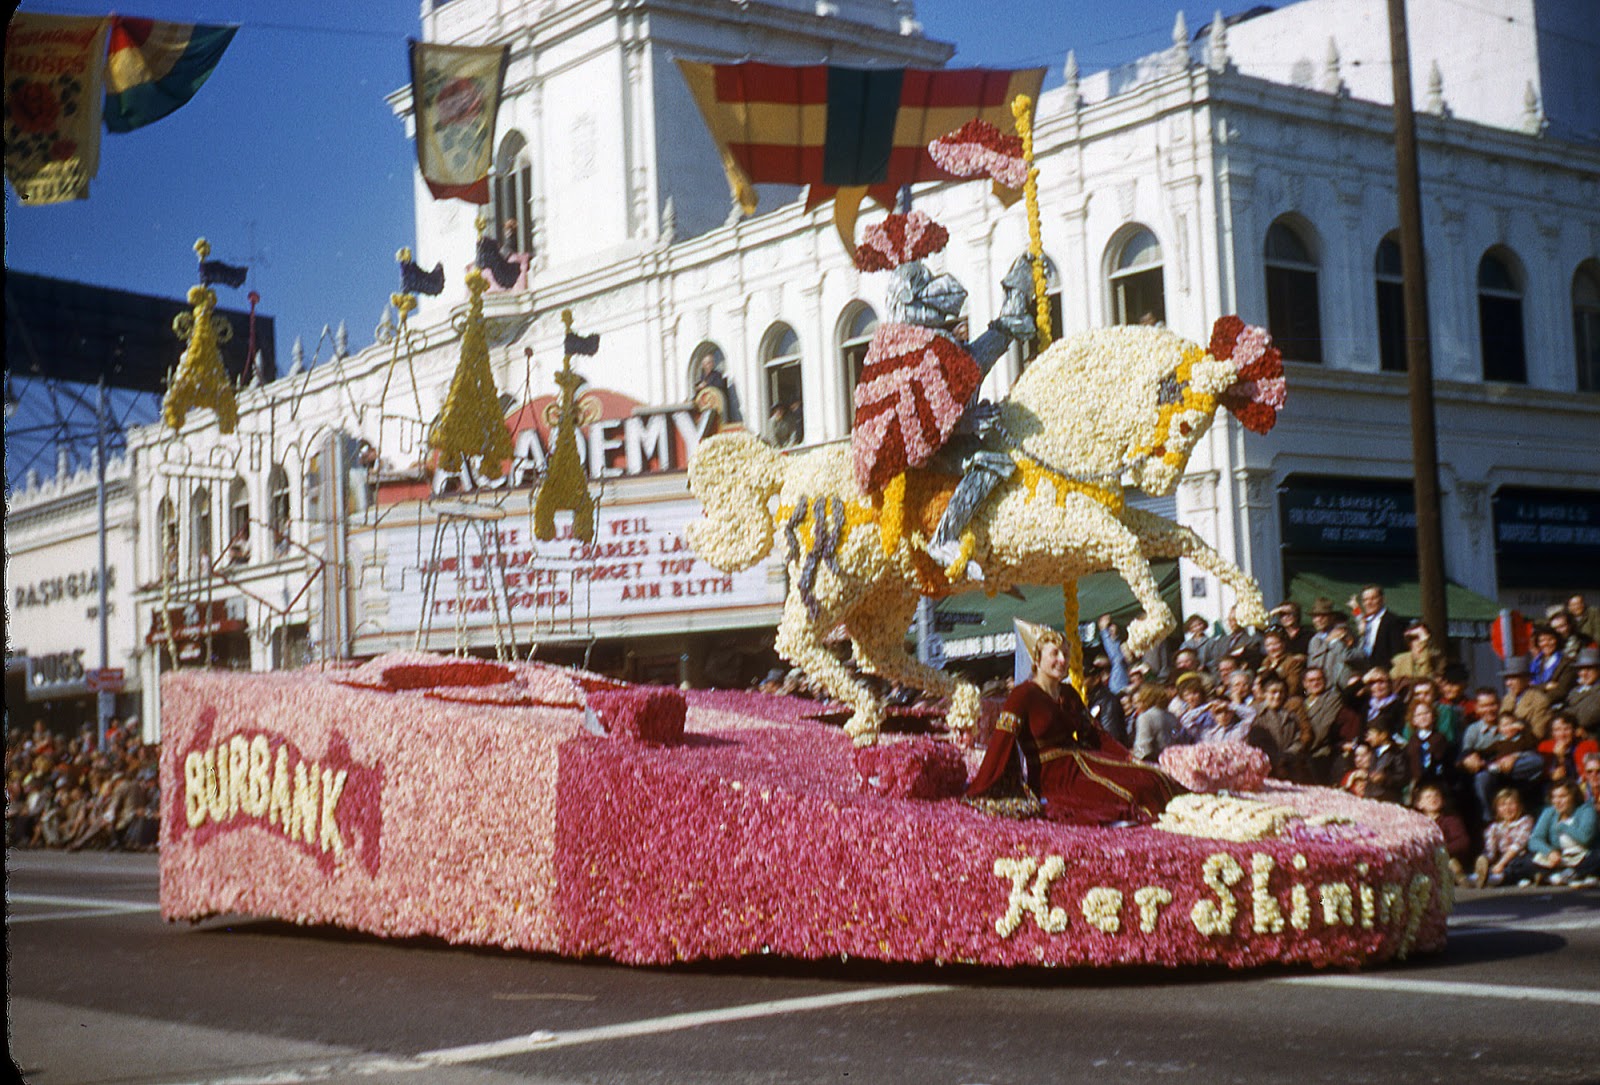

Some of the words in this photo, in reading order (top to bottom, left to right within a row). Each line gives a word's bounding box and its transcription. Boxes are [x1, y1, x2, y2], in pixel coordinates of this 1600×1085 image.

[609, 517, 652, 536] VEIL
[569, 540, 650, 561] CHARLES
[658, 557, 696, 576] YOU
[620, 582, 662, 602] ANN
[672, 577, 734, 598] BLYTH
[184, 733, 349, 858] BURBANK
